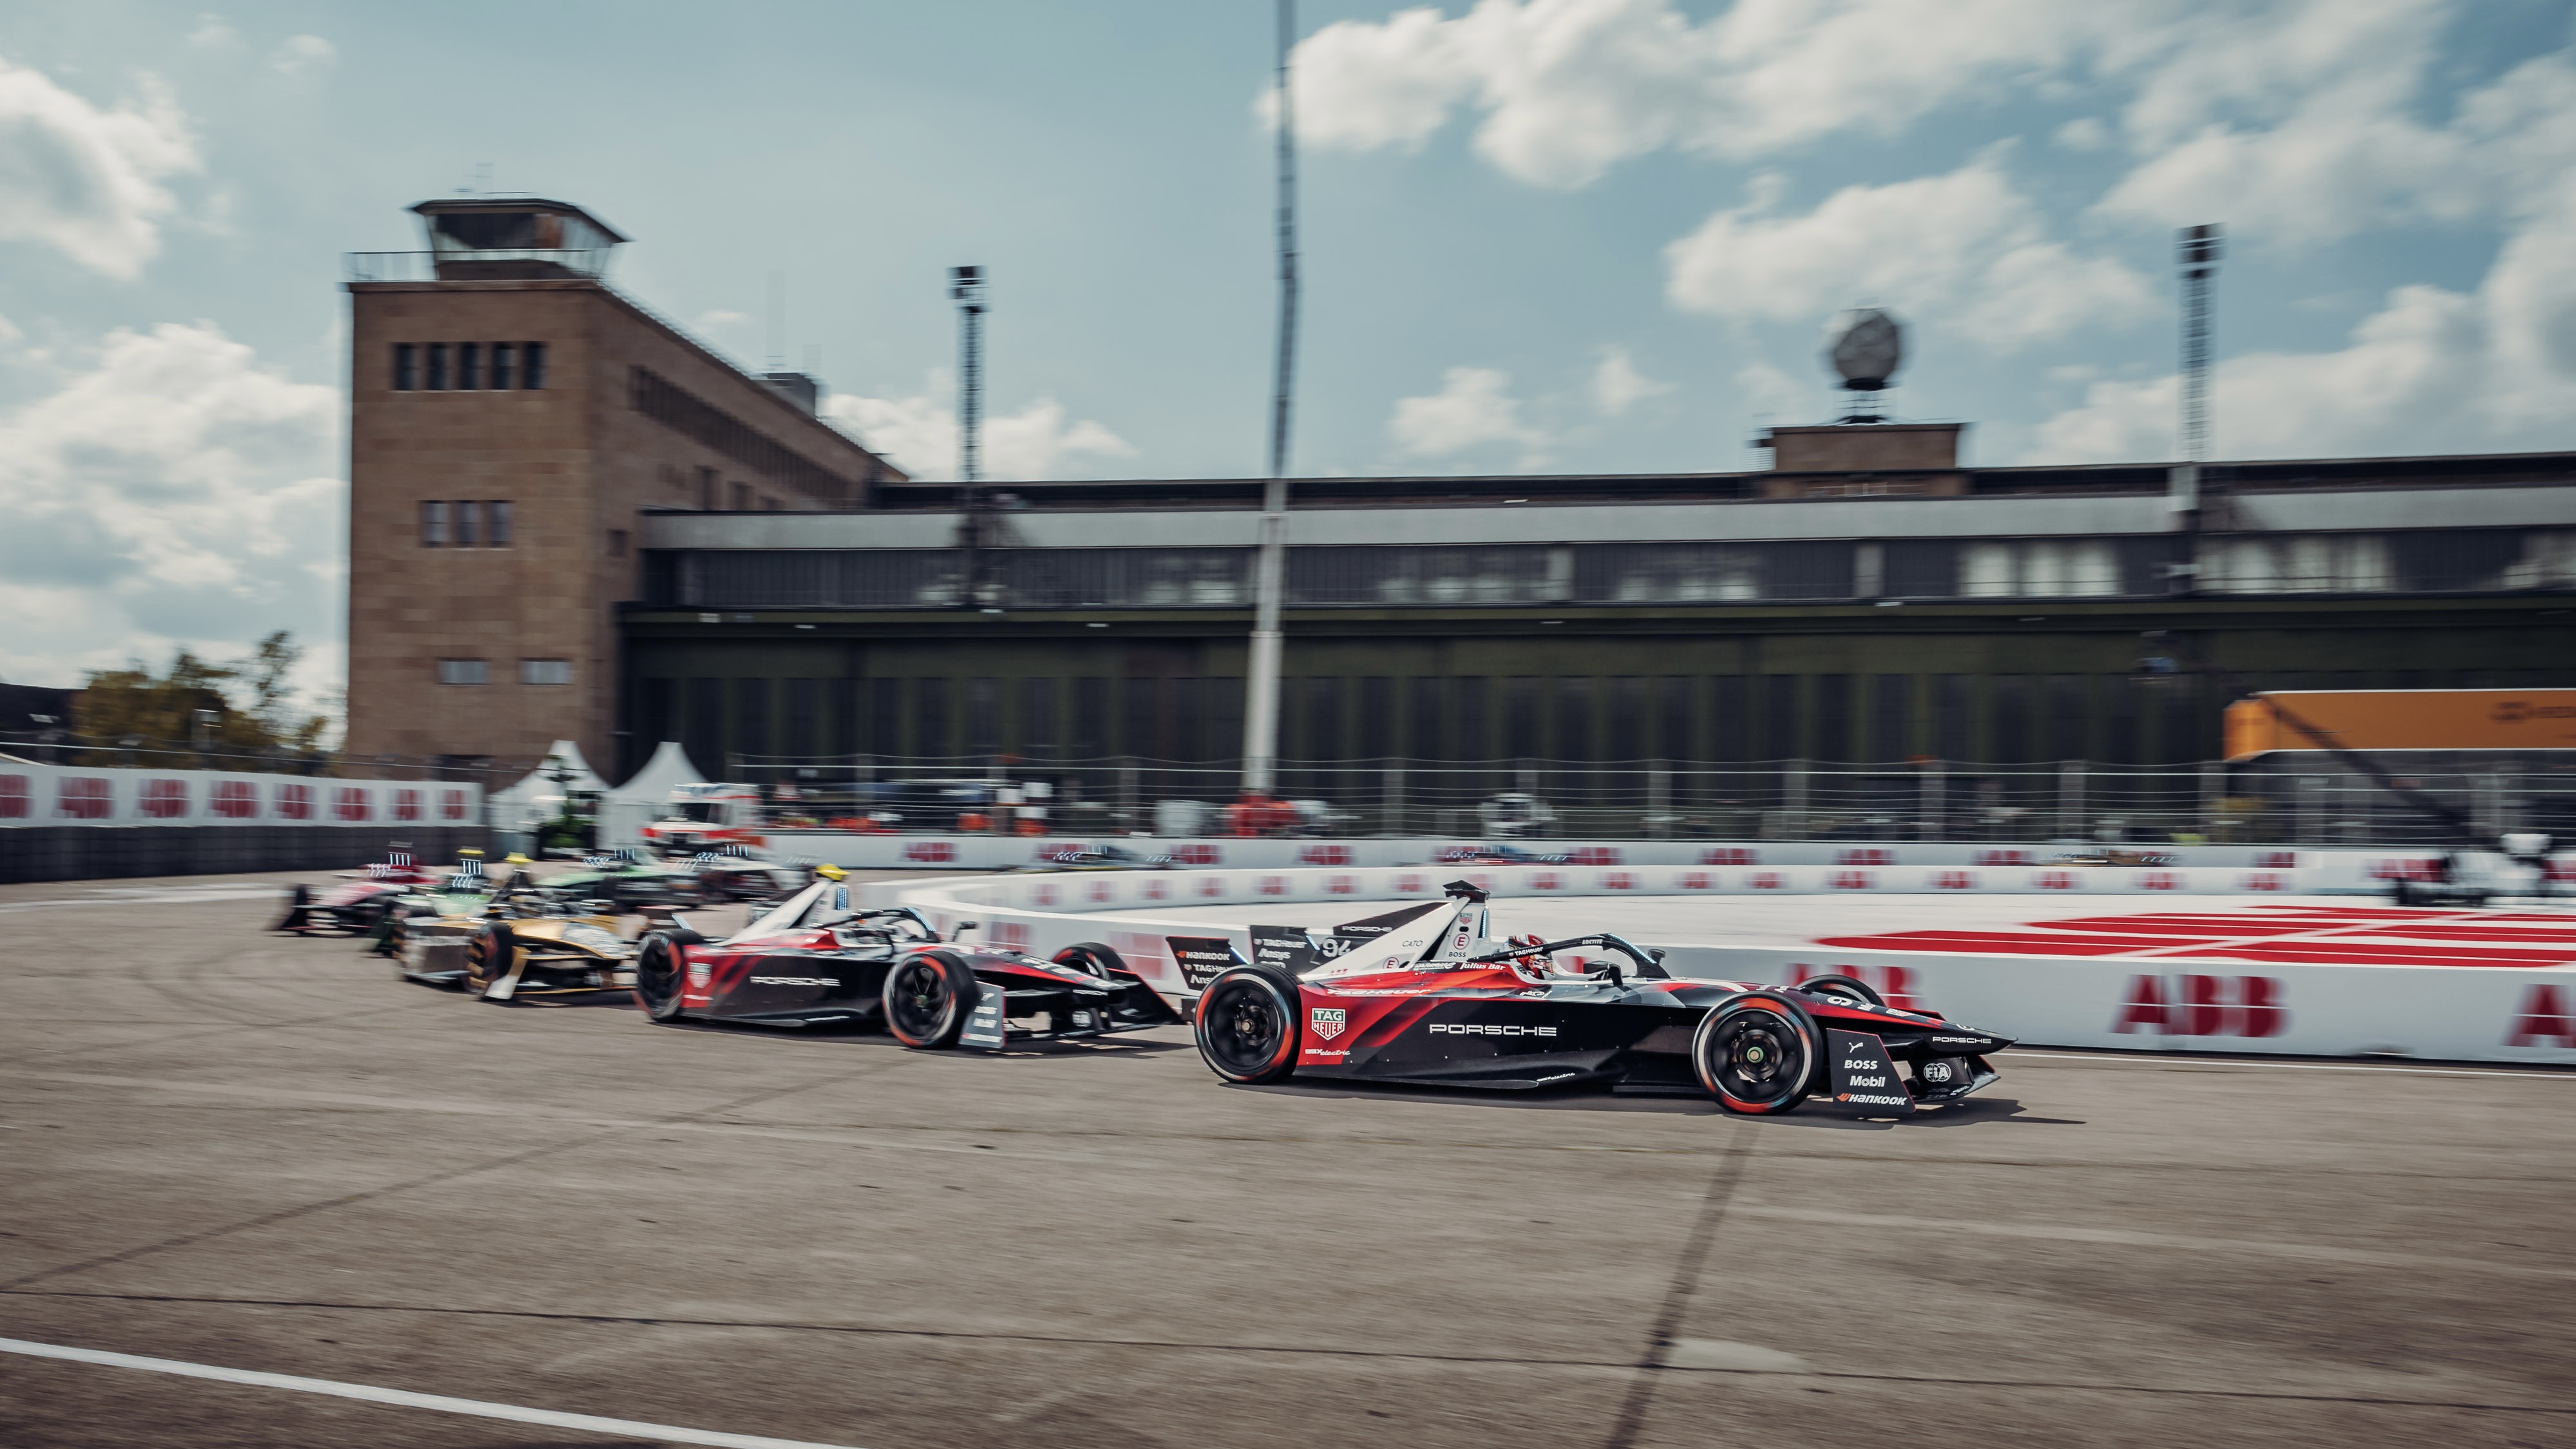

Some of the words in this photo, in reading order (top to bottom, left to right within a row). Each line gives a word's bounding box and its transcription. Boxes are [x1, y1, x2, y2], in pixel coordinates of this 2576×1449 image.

[1258, 948, 1291, 960] Ansys
[1322, 938, 1352, 958] 94
[1514, 947, 1544, 956] TAGHeuer
[1190, 974, 1213, 984] Ans
[2109, 974, 2290, 1037] ABB
[1315, 1010, 1343, 1021] TAG
[1314, 1022, 1343, 1038] HEUER
[1429, 1024, 1557, 1036] PORSCHE
[1844, 1059, 1878, 1070] BOSS
[1850, 1075, 1886, 1087] Mobil
